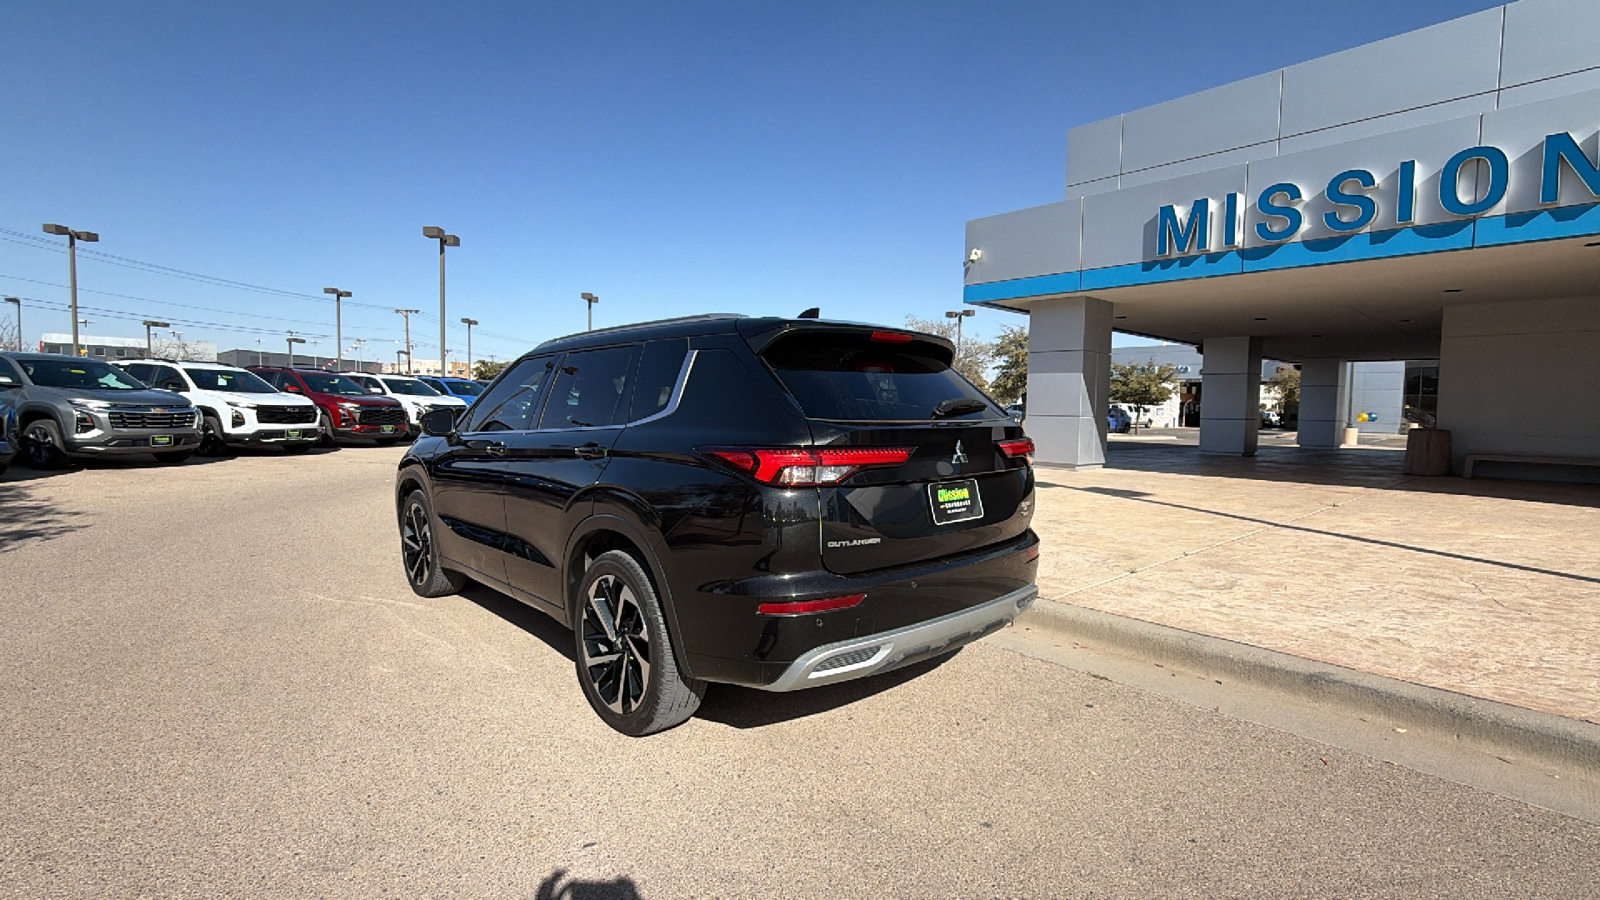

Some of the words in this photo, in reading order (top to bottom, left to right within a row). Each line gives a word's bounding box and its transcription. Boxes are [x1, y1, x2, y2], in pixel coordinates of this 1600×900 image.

[1156, 131, 1600, 256] MISSION
[937, 487, 970, 502] Mission
[827, 537, 881, 548] OUTLANDER
